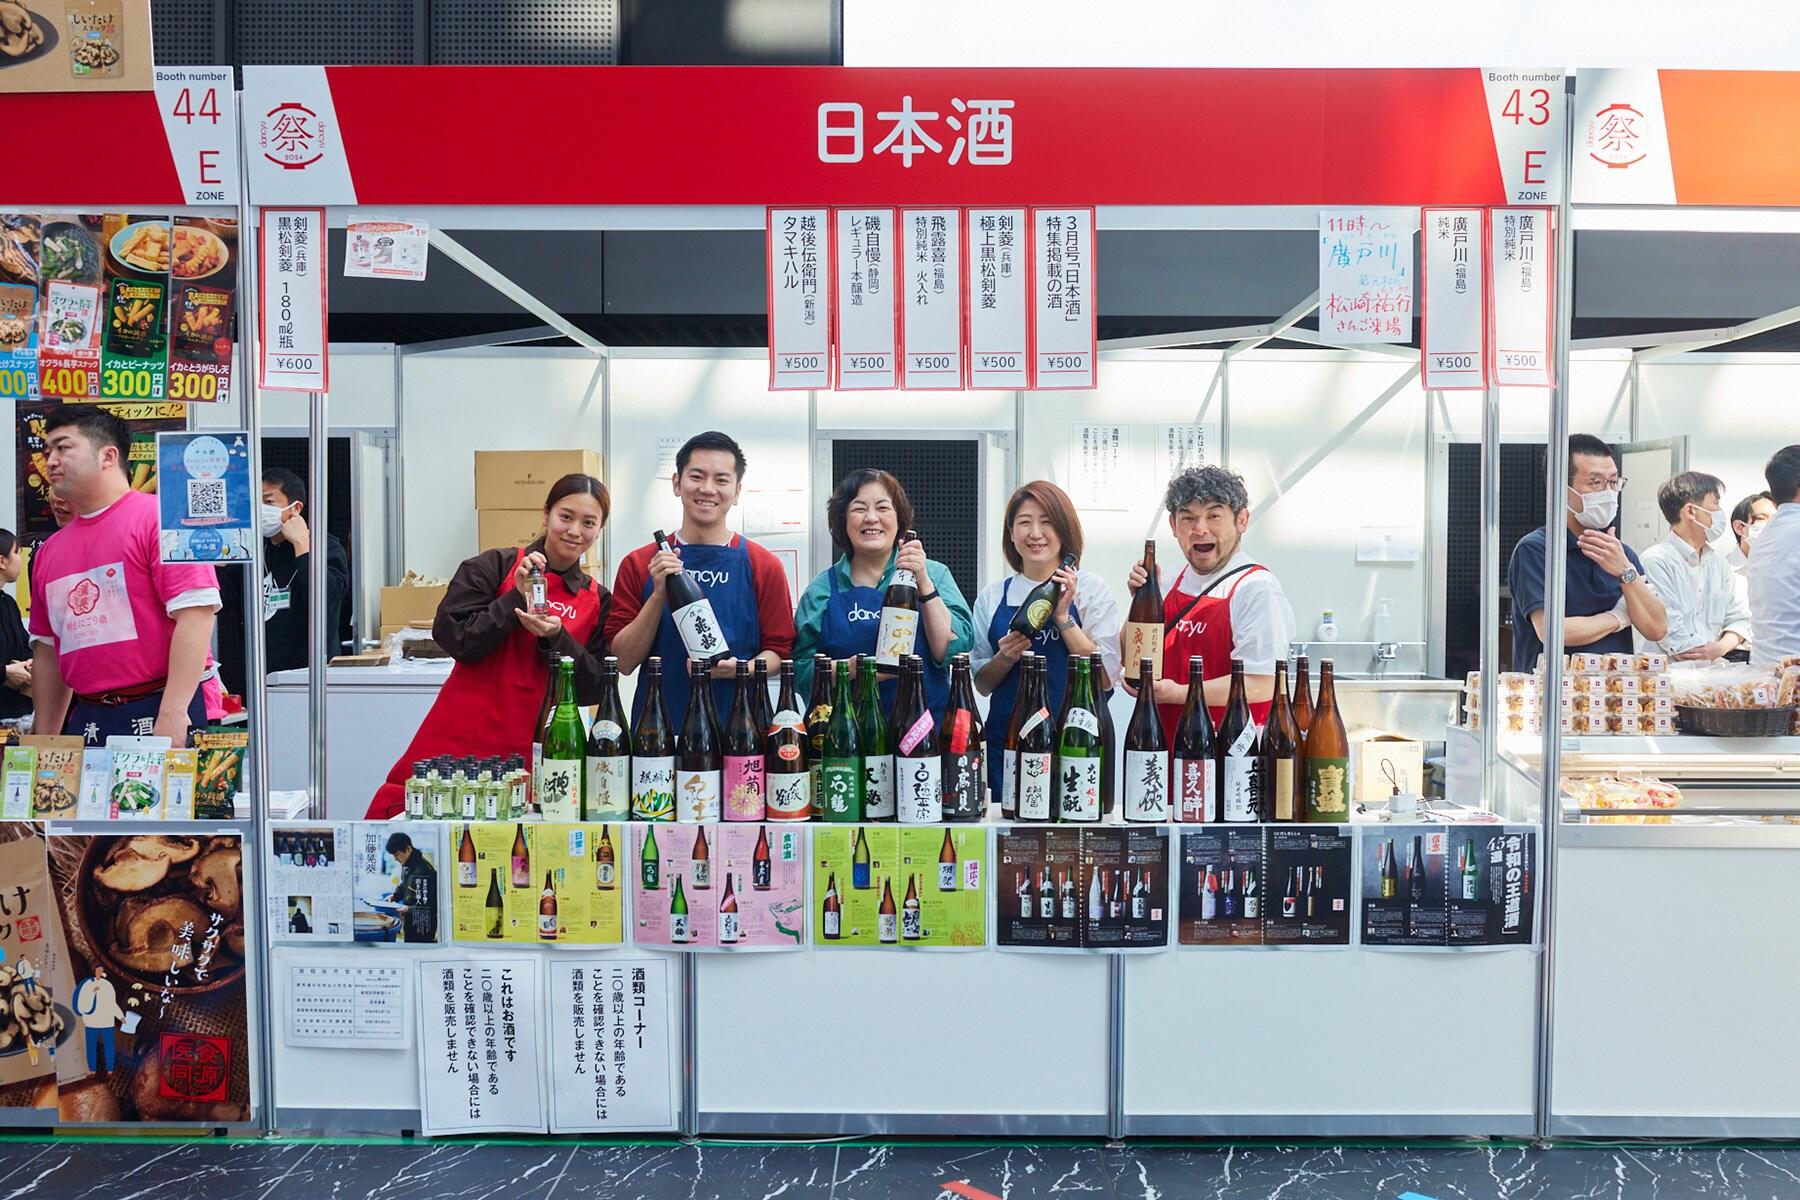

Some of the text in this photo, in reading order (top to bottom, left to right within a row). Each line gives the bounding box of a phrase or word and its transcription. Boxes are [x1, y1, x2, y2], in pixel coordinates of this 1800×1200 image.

[156, 72, 227, 81] Booth number
[1488, 73, 1561, 82] Booth number
[173, 88, 221, 125] 44
[1502, 89, 1550, 125] 43
[271, 113, 315, 152] 祭
[817, 95, 1016, 168] 日本酒
[1598, 114, 1640, 151] 祭
[200, 150, 222, 184] E
[1524, 150, 1547, 184] E
[196, 191, 225, 200] ZONE
[1518, 191, 1548, 200] ZONE
[278, 216, 293, 273] 黒松剣菱
[1438, 216, 1450, 240] 純米
[1504, 215, 1516, 262] 特別純米
[783, 216, 799, 289] タマキハル
[850, 216, 863, 306] レギュラー本醸造
[915, 216, 929, 306] 特別純米 火入れ
[980, 216, 996, 310] 極上黒松剣菱
[1046, 216, 1062, 309] 特集掲載の酒
[105, 360, 165, 370] イカとピーナッツ
[169, 362, 230, 375] イカととうがらし天
[277, 357, 313, 370] ¥600
[784, 356, 818, 369] ¥500
[850, 356, 885, 369] ¥500
[915, 356, 950, 369] ¥500
[981, 356, 1016, 368] ¥500
[1048, 356, 1082, 369] ¥500
[1436, 356, 1472, 369] ¥500
[1505, 354, 1537, 367] ¥500
[193, 912, 224, 982] サクサクで
[442, 968, 459, 1074] 酒類を販売しません
[500, 968, 518, 1062] これはお酒です
[572, 968, 586, 1075] 酒類を販売しません
[632, 968, 646, 1049] 酒類コーナー
[463, 968, 481, 1119] ことを確認できない場合には
[592, 968, 608, 1120] ことを確認できない場合には
